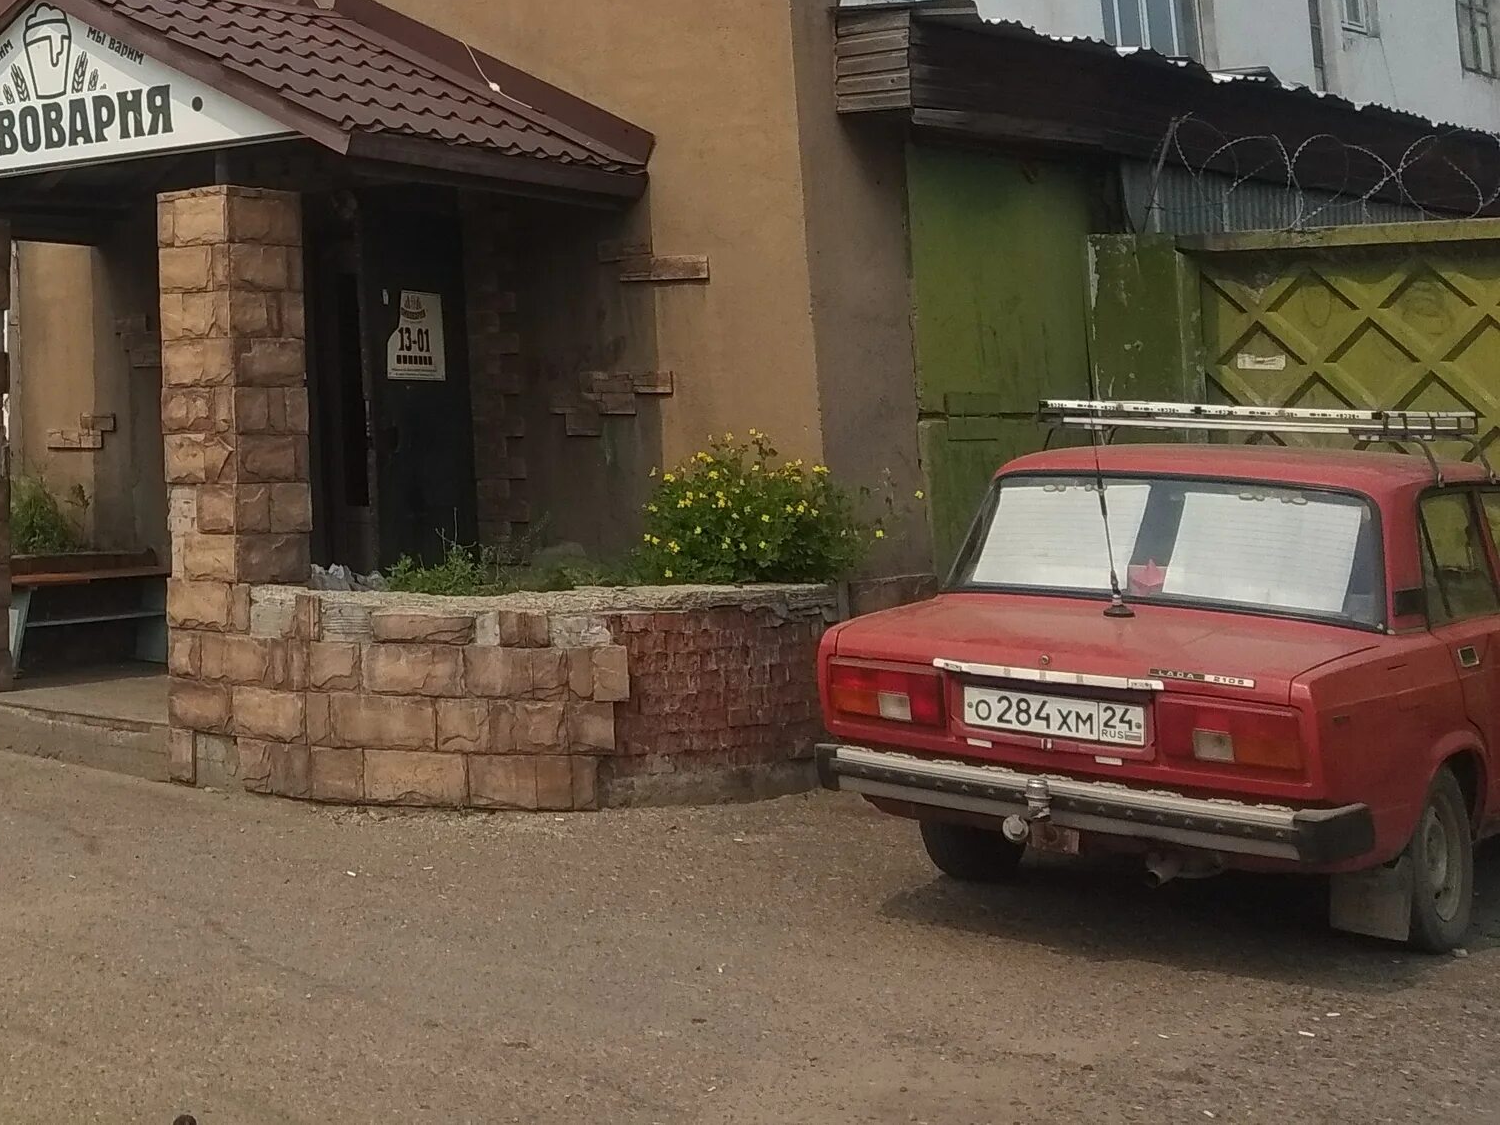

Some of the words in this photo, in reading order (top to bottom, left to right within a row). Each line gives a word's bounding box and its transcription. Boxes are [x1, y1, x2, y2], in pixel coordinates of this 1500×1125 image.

[398, 327, 431, 353] 13-01
[1102, 705, 1133, 732] 24
[1101, 728, 1125, 740] RUS
